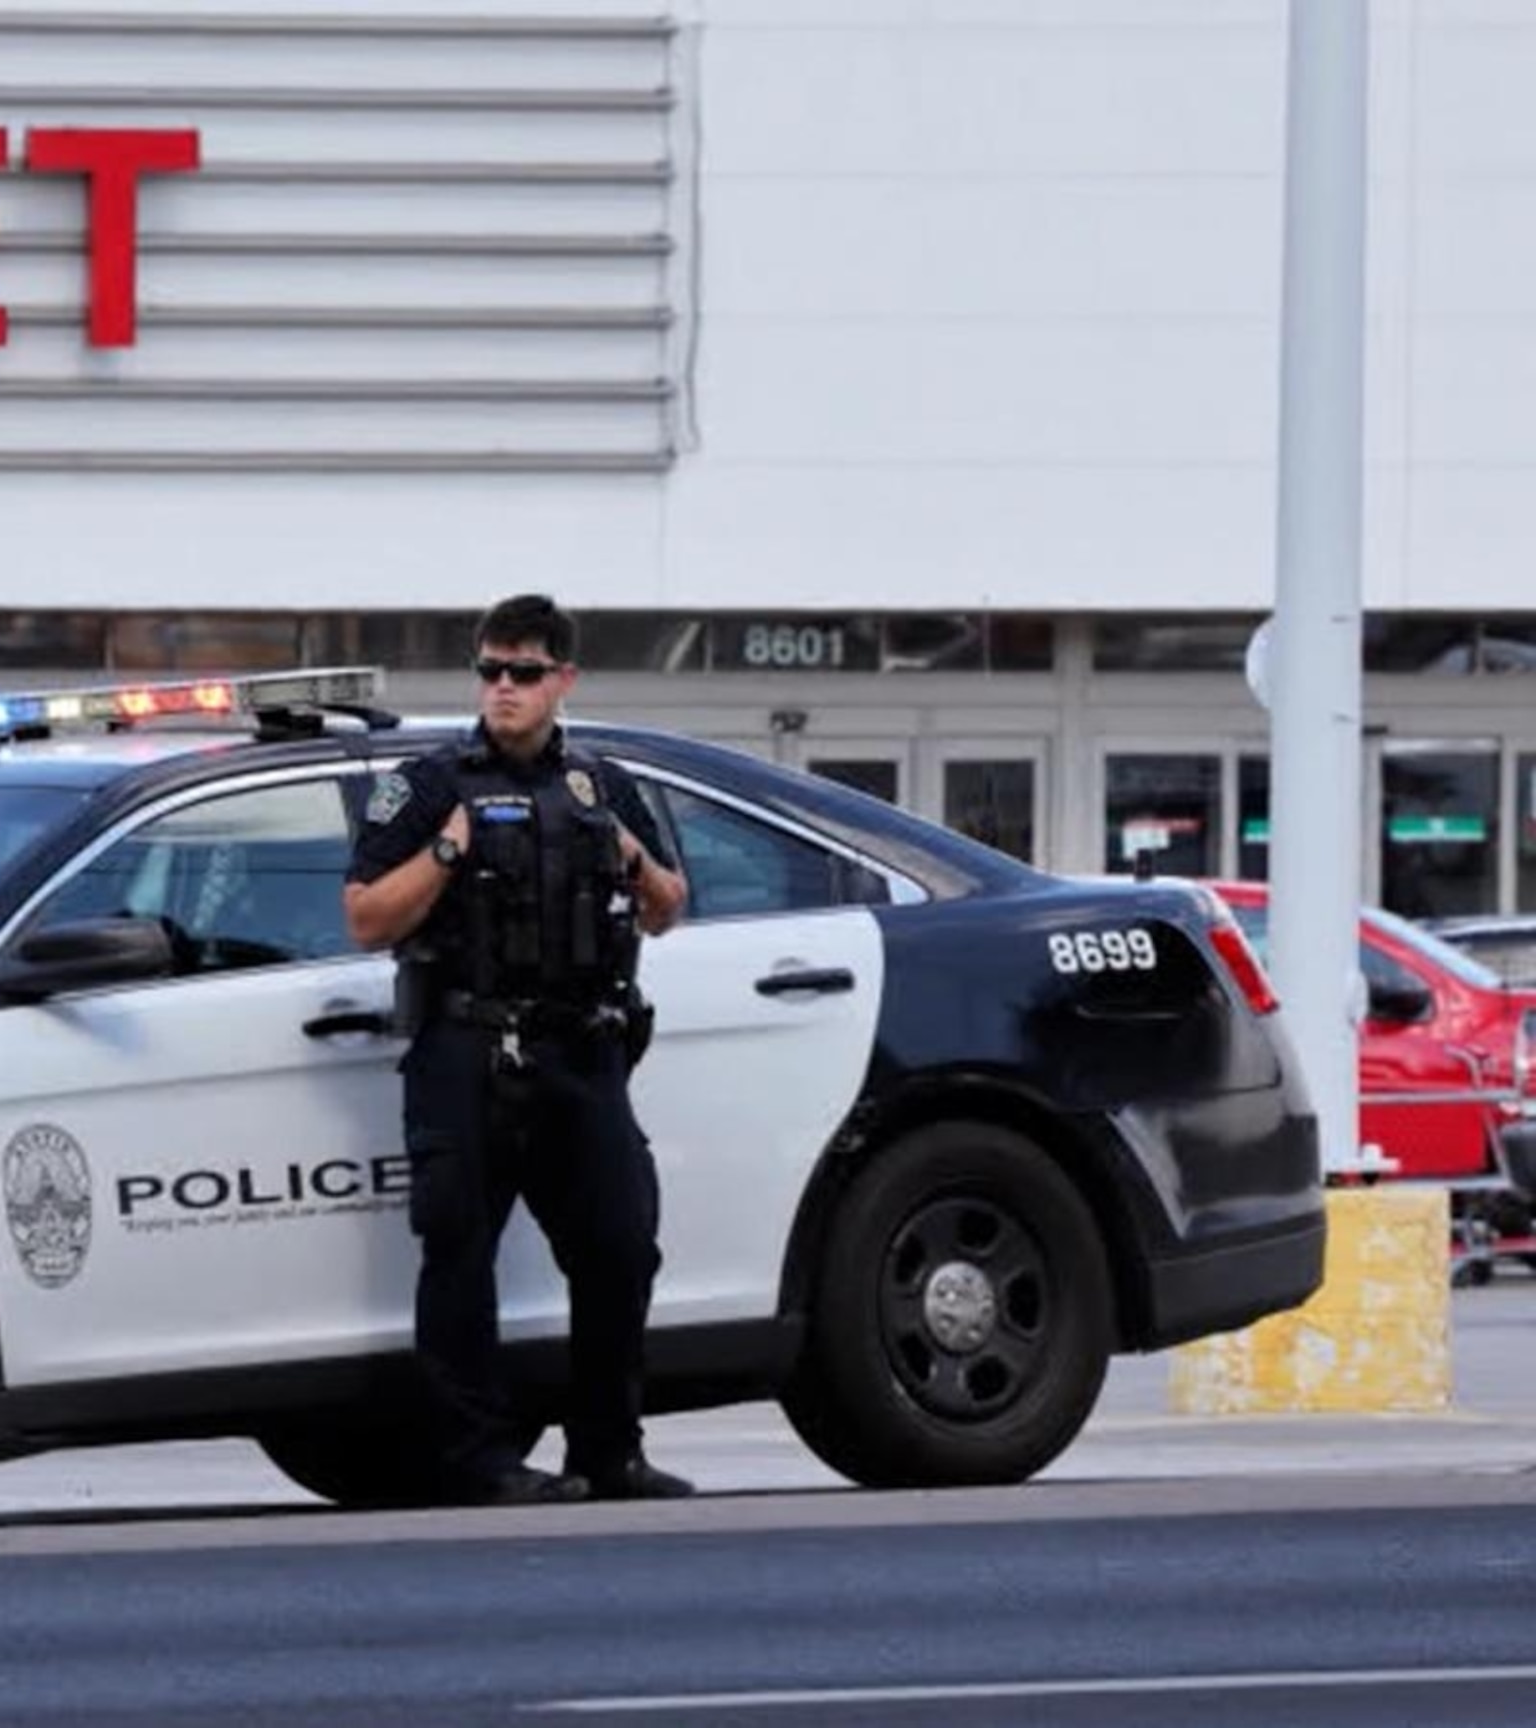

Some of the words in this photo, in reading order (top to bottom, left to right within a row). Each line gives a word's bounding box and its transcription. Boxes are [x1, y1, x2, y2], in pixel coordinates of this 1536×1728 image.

[743, 624, 844, 665] 8601
[1048, 929, 1156, 973] 8699
[117, 1155, 412, 1215] POLICE
